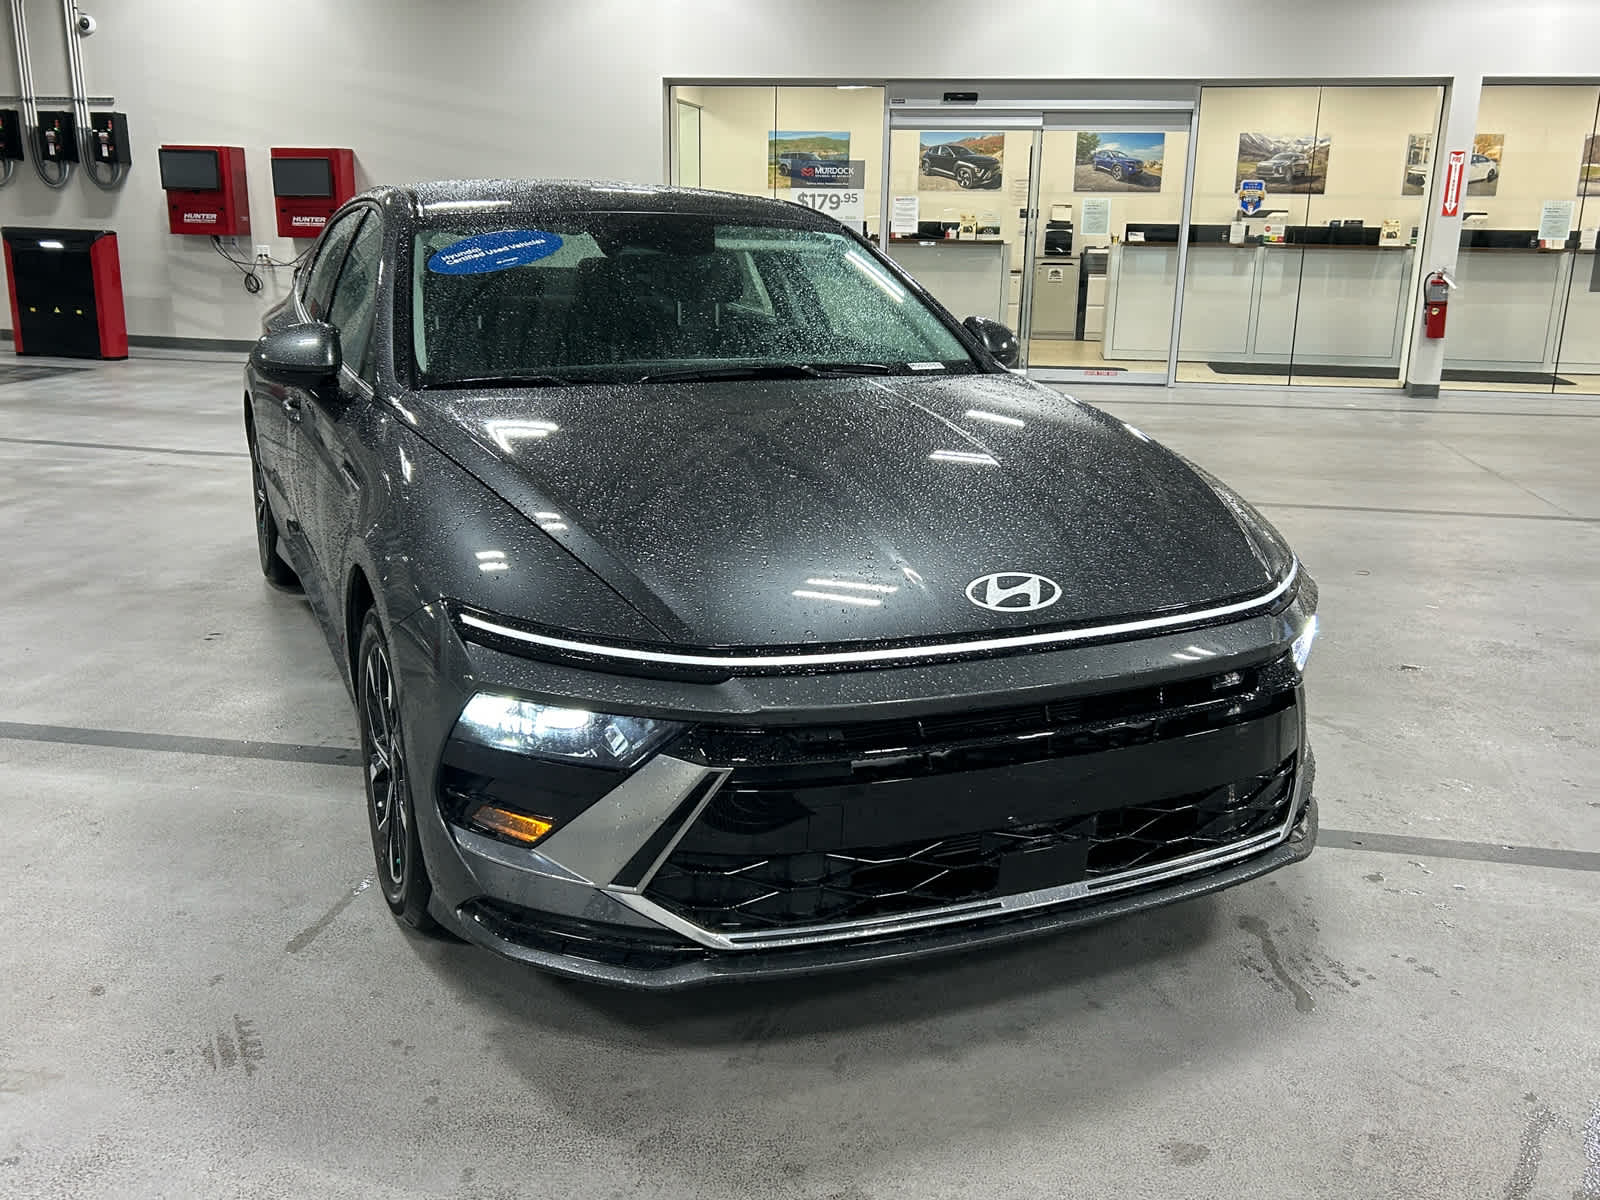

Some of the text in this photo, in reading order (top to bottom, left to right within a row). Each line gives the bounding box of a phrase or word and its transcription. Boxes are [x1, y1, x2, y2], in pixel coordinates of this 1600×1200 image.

[815, 167, 854, 175] MURDOCK
[797, 192, 858, 210] $179.95
[441, 247, 482, 261] Hyundai
[487, 246, 510, 255] Used
[510, 239, 546, 249] Vehicles
